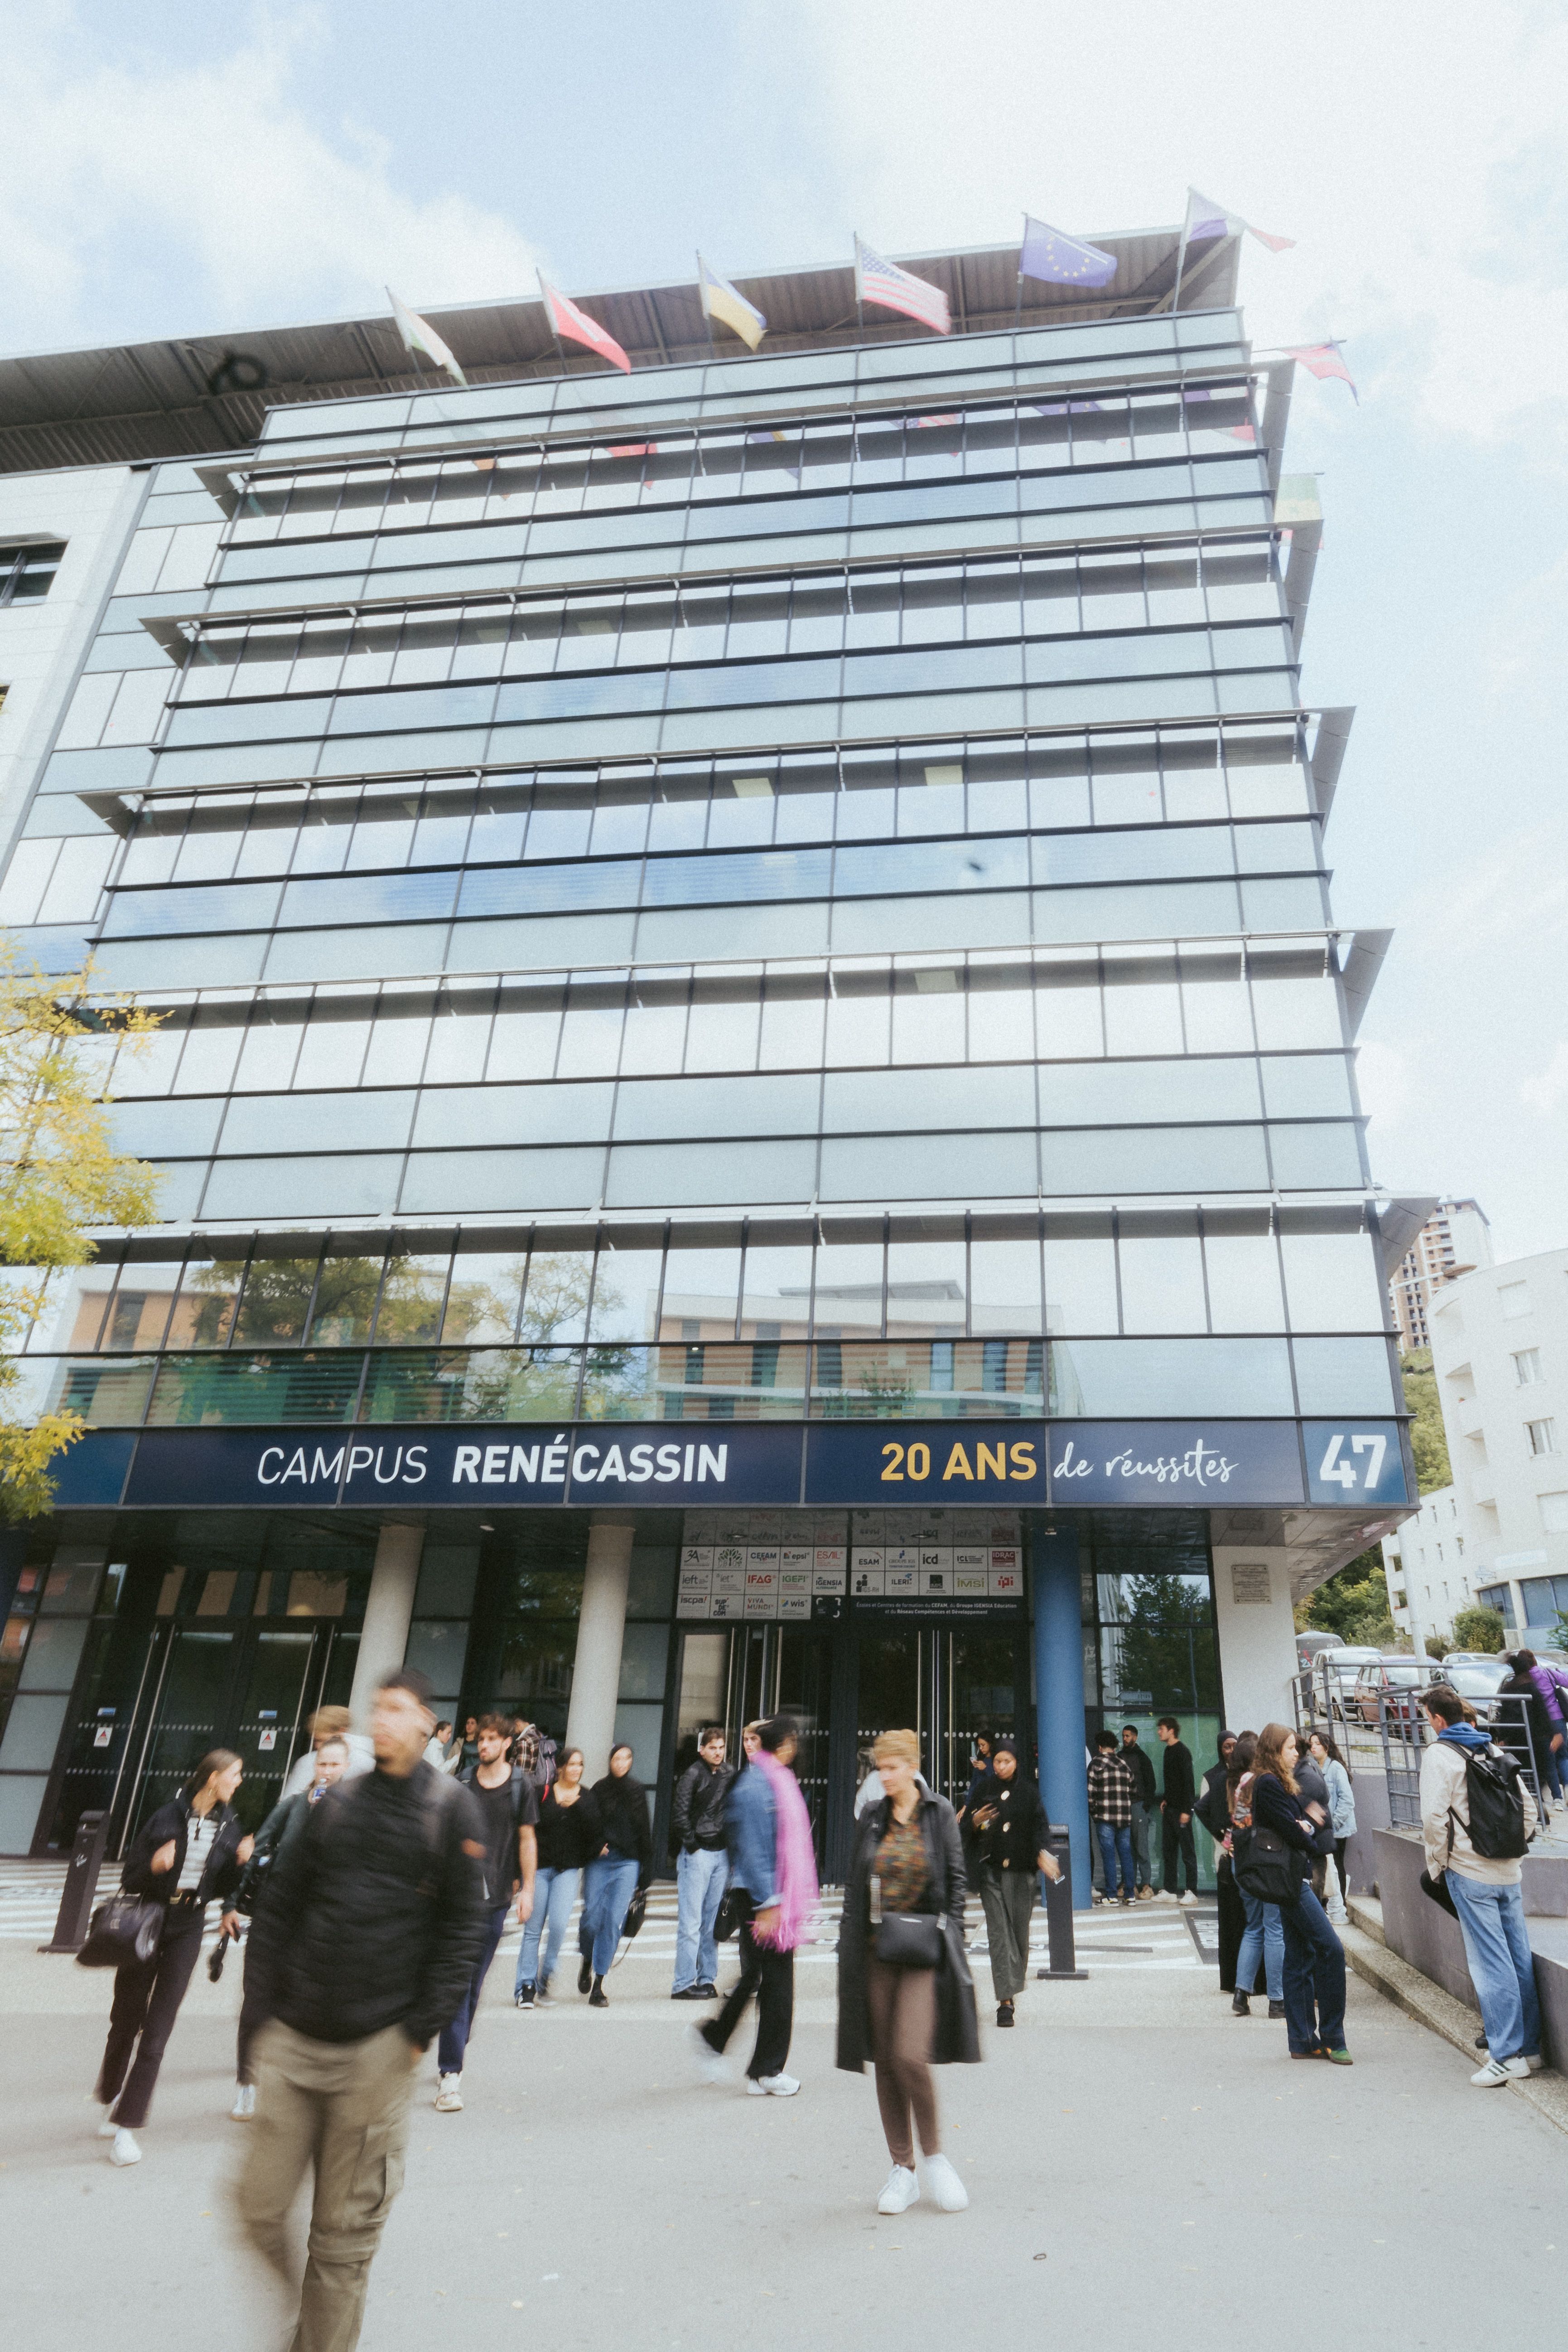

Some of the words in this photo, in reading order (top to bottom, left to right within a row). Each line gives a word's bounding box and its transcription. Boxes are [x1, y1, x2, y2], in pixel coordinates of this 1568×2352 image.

[257, 1446, 428, 1484] CAMPUS
[881, 1442, 931, 1481] 20
[942, 1441, 1037, 1481] ANS
[1053, 1441, 1095, 1478] de
[1105, 1439, 1240, 1486] réussites
[1319, 1434, 1387, 1488] 47
[922, 1554, 938, 1564] icd
[682, 1574, 698, 1584] ieft
[748, 1575, 772, 1583] IFAG
[998, 1576, 1013, 1588] ipi
